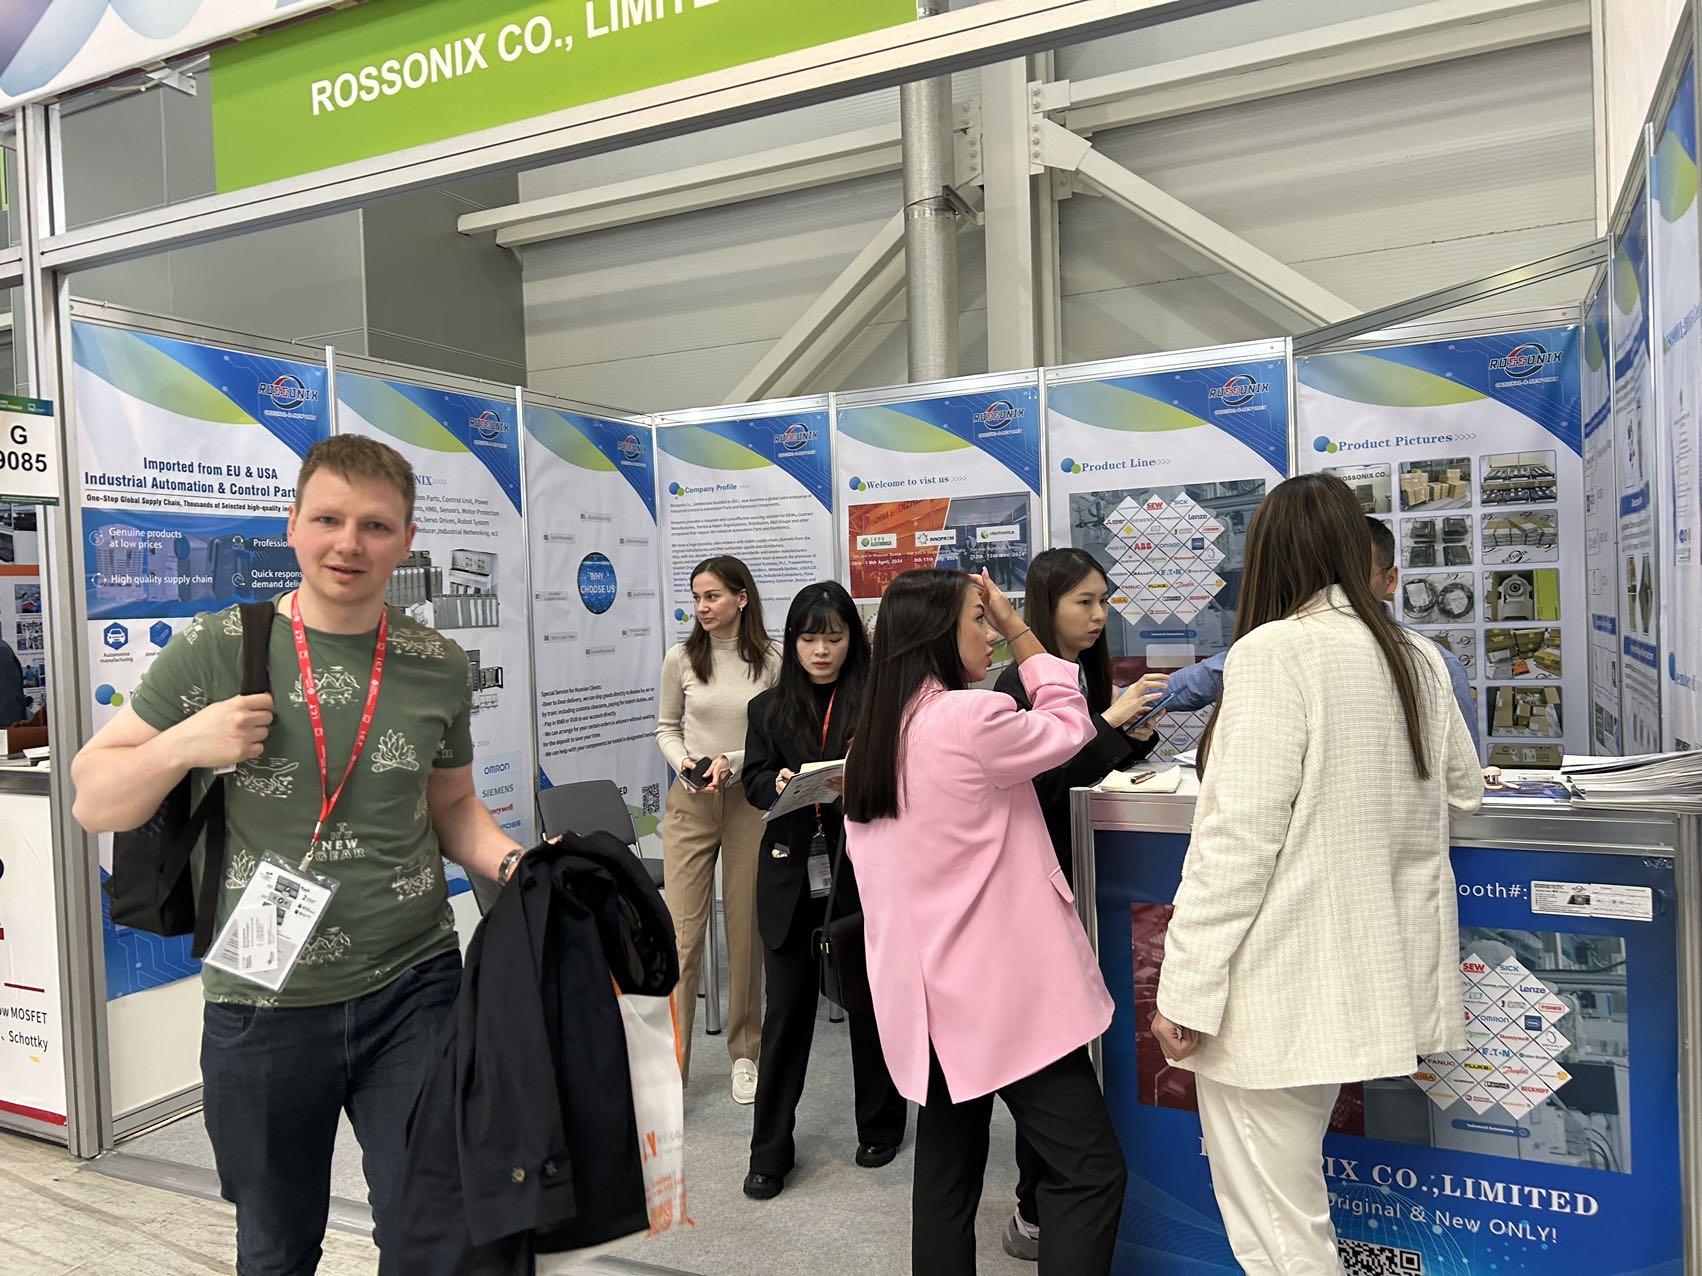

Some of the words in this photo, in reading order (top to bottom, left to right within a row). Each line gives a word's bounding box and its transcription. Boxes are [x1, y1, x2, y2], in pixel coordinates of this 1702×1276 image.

[311, 33, 489, 116] ROSSONIX
[498, 16, 573, 62] CO.,
[585, 0, 719, 39] LIMI
[10, 425, 28, 445] G
[1338, 438, 1390, 452] Product
[1395, 434, 1453, 447] Pictures
[143, 457, 194, 473] Imported
[198, 462, 223, 476] from
[226, 465, 241, 477] EU
[245, 466, 253, 478] &
[257, 467, 278, 480] USA
[1081, 461, 1127, 472] Product
[1130, 459, 1156, 468] Line
[866, 478, 905, 489] Welcome
[919, 475, 938, 485] vist
[1339, 473, 1374, 481] OSSONIX
[85, 472, 147, 488] Industrial
[151, 477, 214, 493] Automation
[218, 482, 226, 494] &
[230, 483, 270, 497] Control
[685, 486, 715, 494] Company
[716, 483, 737, 491] Profile
[86, 494, 119, 504] One-Stop
[120, 496, 140, 504] Global
[142, 497, 162, 506] Supply
[163, 499, 182, 507] Chain,
[183, 500, 213, 508] Thousands
[247, 504, 281, 512] high-quality
[109, 528, 146, 537] Genuine
[147, 529, 182, 539] products
[109, 540, 119, 548] at
[120, 540, 137, 548] low
[138, 542, 163, 551] prices
[1134, 542, 1153, 551] ABB
[251, 569, 274, 578] Quick
[589, 572, 604, 580] WHY
[111, 574, 132, 583] High
[134, 574, 161, 585] quality
[163, 576, 190, 585] supply
[191, 575, 213, 583] chain
[251, 580, 283, 588] demand
[580, 584, 606, 593] CHOOSE
[606, 584, 616, 593] US
[483, 762, 511, 775] OMRON
[481, 784, 514, 798] SIEMENS
[321, 838, 359, 851] NEW
[1462, 962, 1485, 971] SEW
[1500, 964, 1520, 972] SICK
[1519, 985, 1546, 994] Lenze
[11, 1006, 47, 1025] MOSFET
[1480, 1015, 1510, 1023] OMRON
[9, 1030, 48, 1052] Schottky
[1427, 1058, 1456, 1067] FANUC
[1410, 1206, 1427, 1223] &
[1435, 1210, 1480, 1231] New
[1489, 1218, 1558, 1244] ONLY!
